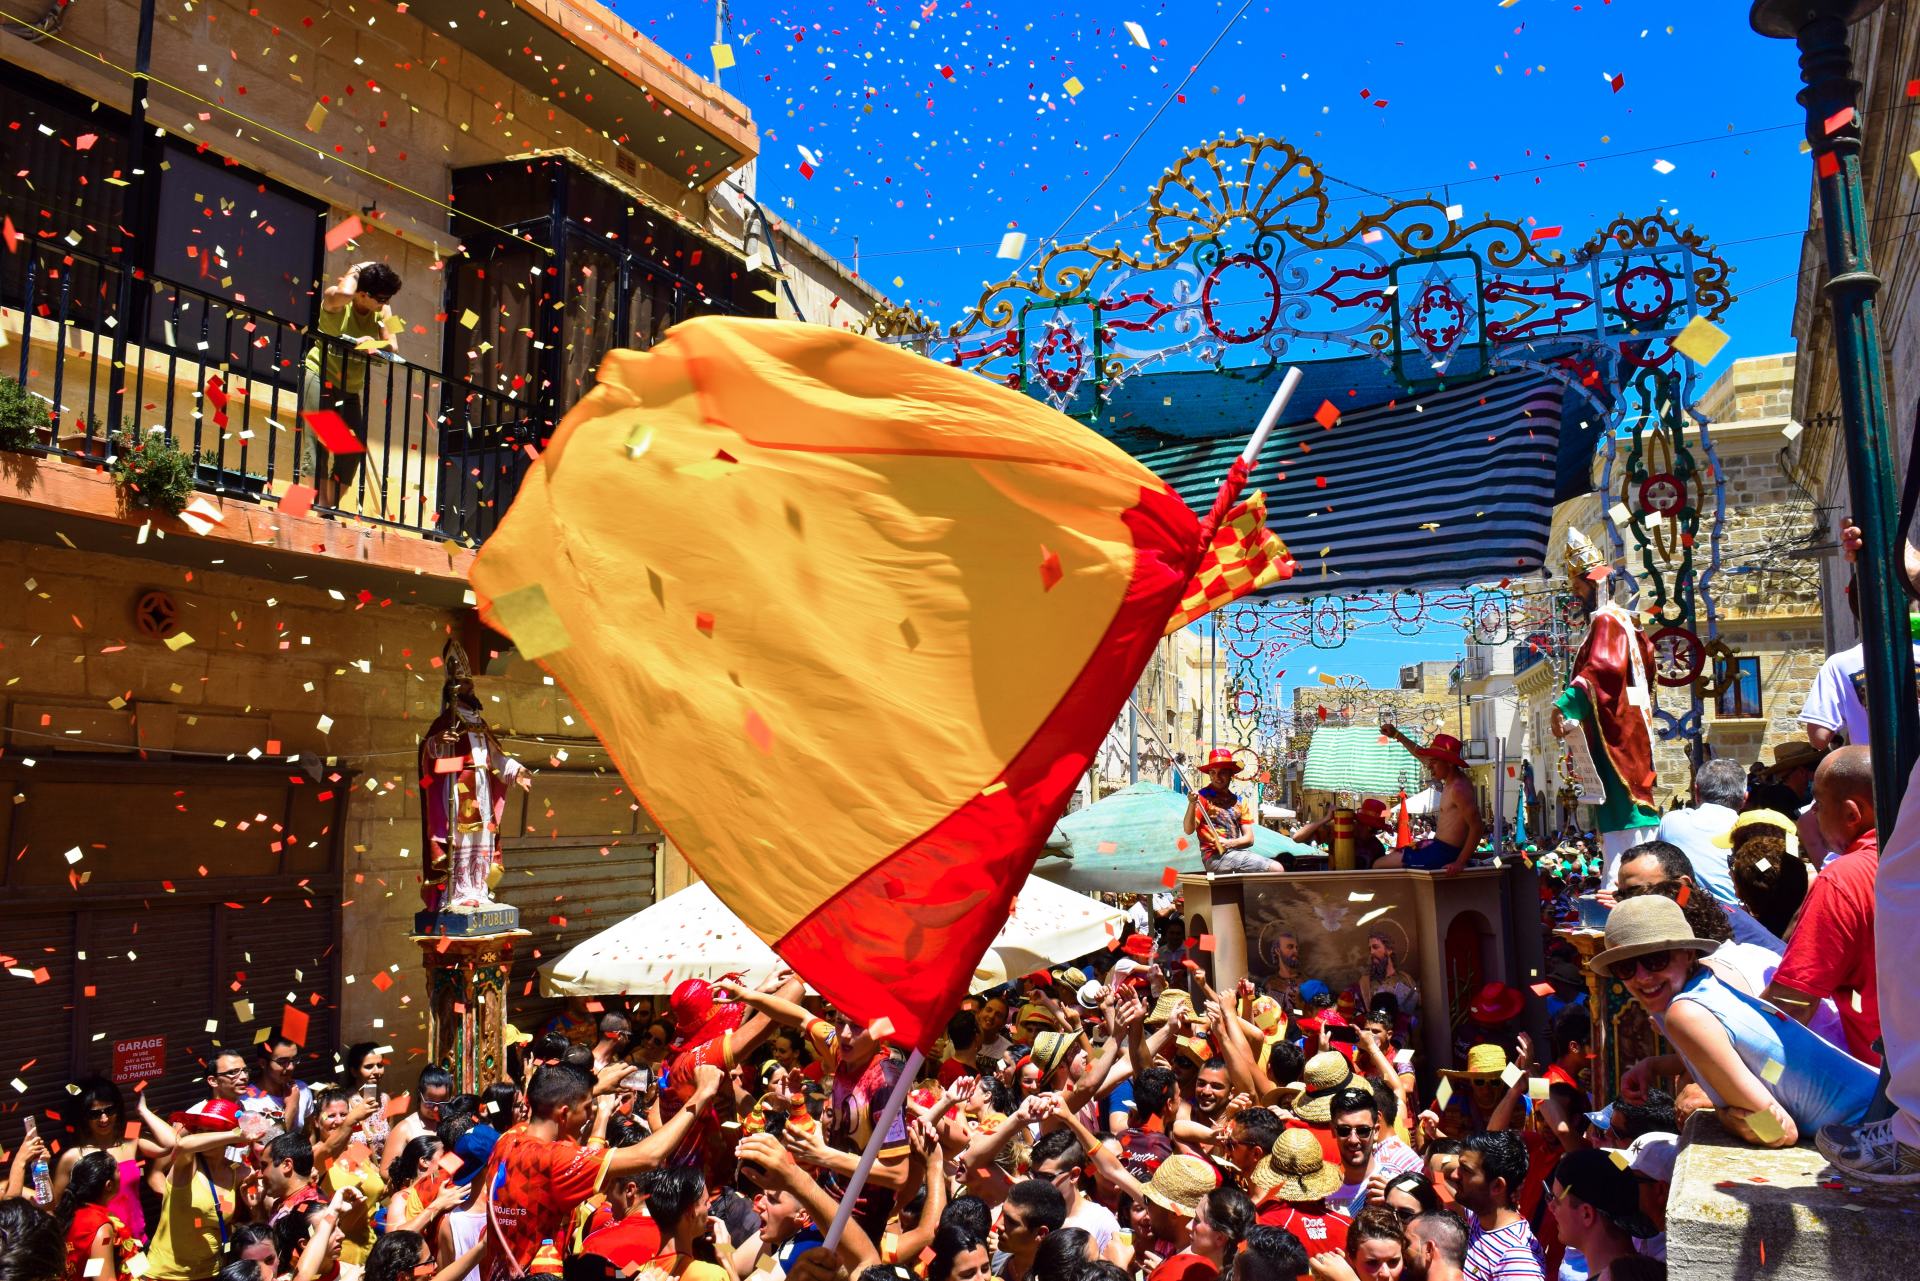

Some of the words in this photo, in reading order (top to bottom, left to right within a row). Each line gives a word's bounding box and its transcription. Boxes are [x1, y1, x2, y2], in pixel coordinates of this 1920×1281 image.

[117, 1038, 163, 1052] GARAGE
[123, 1061, 157, 1072] STRICTLY
[117, 1073, 127, 1081] NO
[129, 1068, 163, 1079] PARKING
[494, 1205, 527, 1216] ROJECTS
